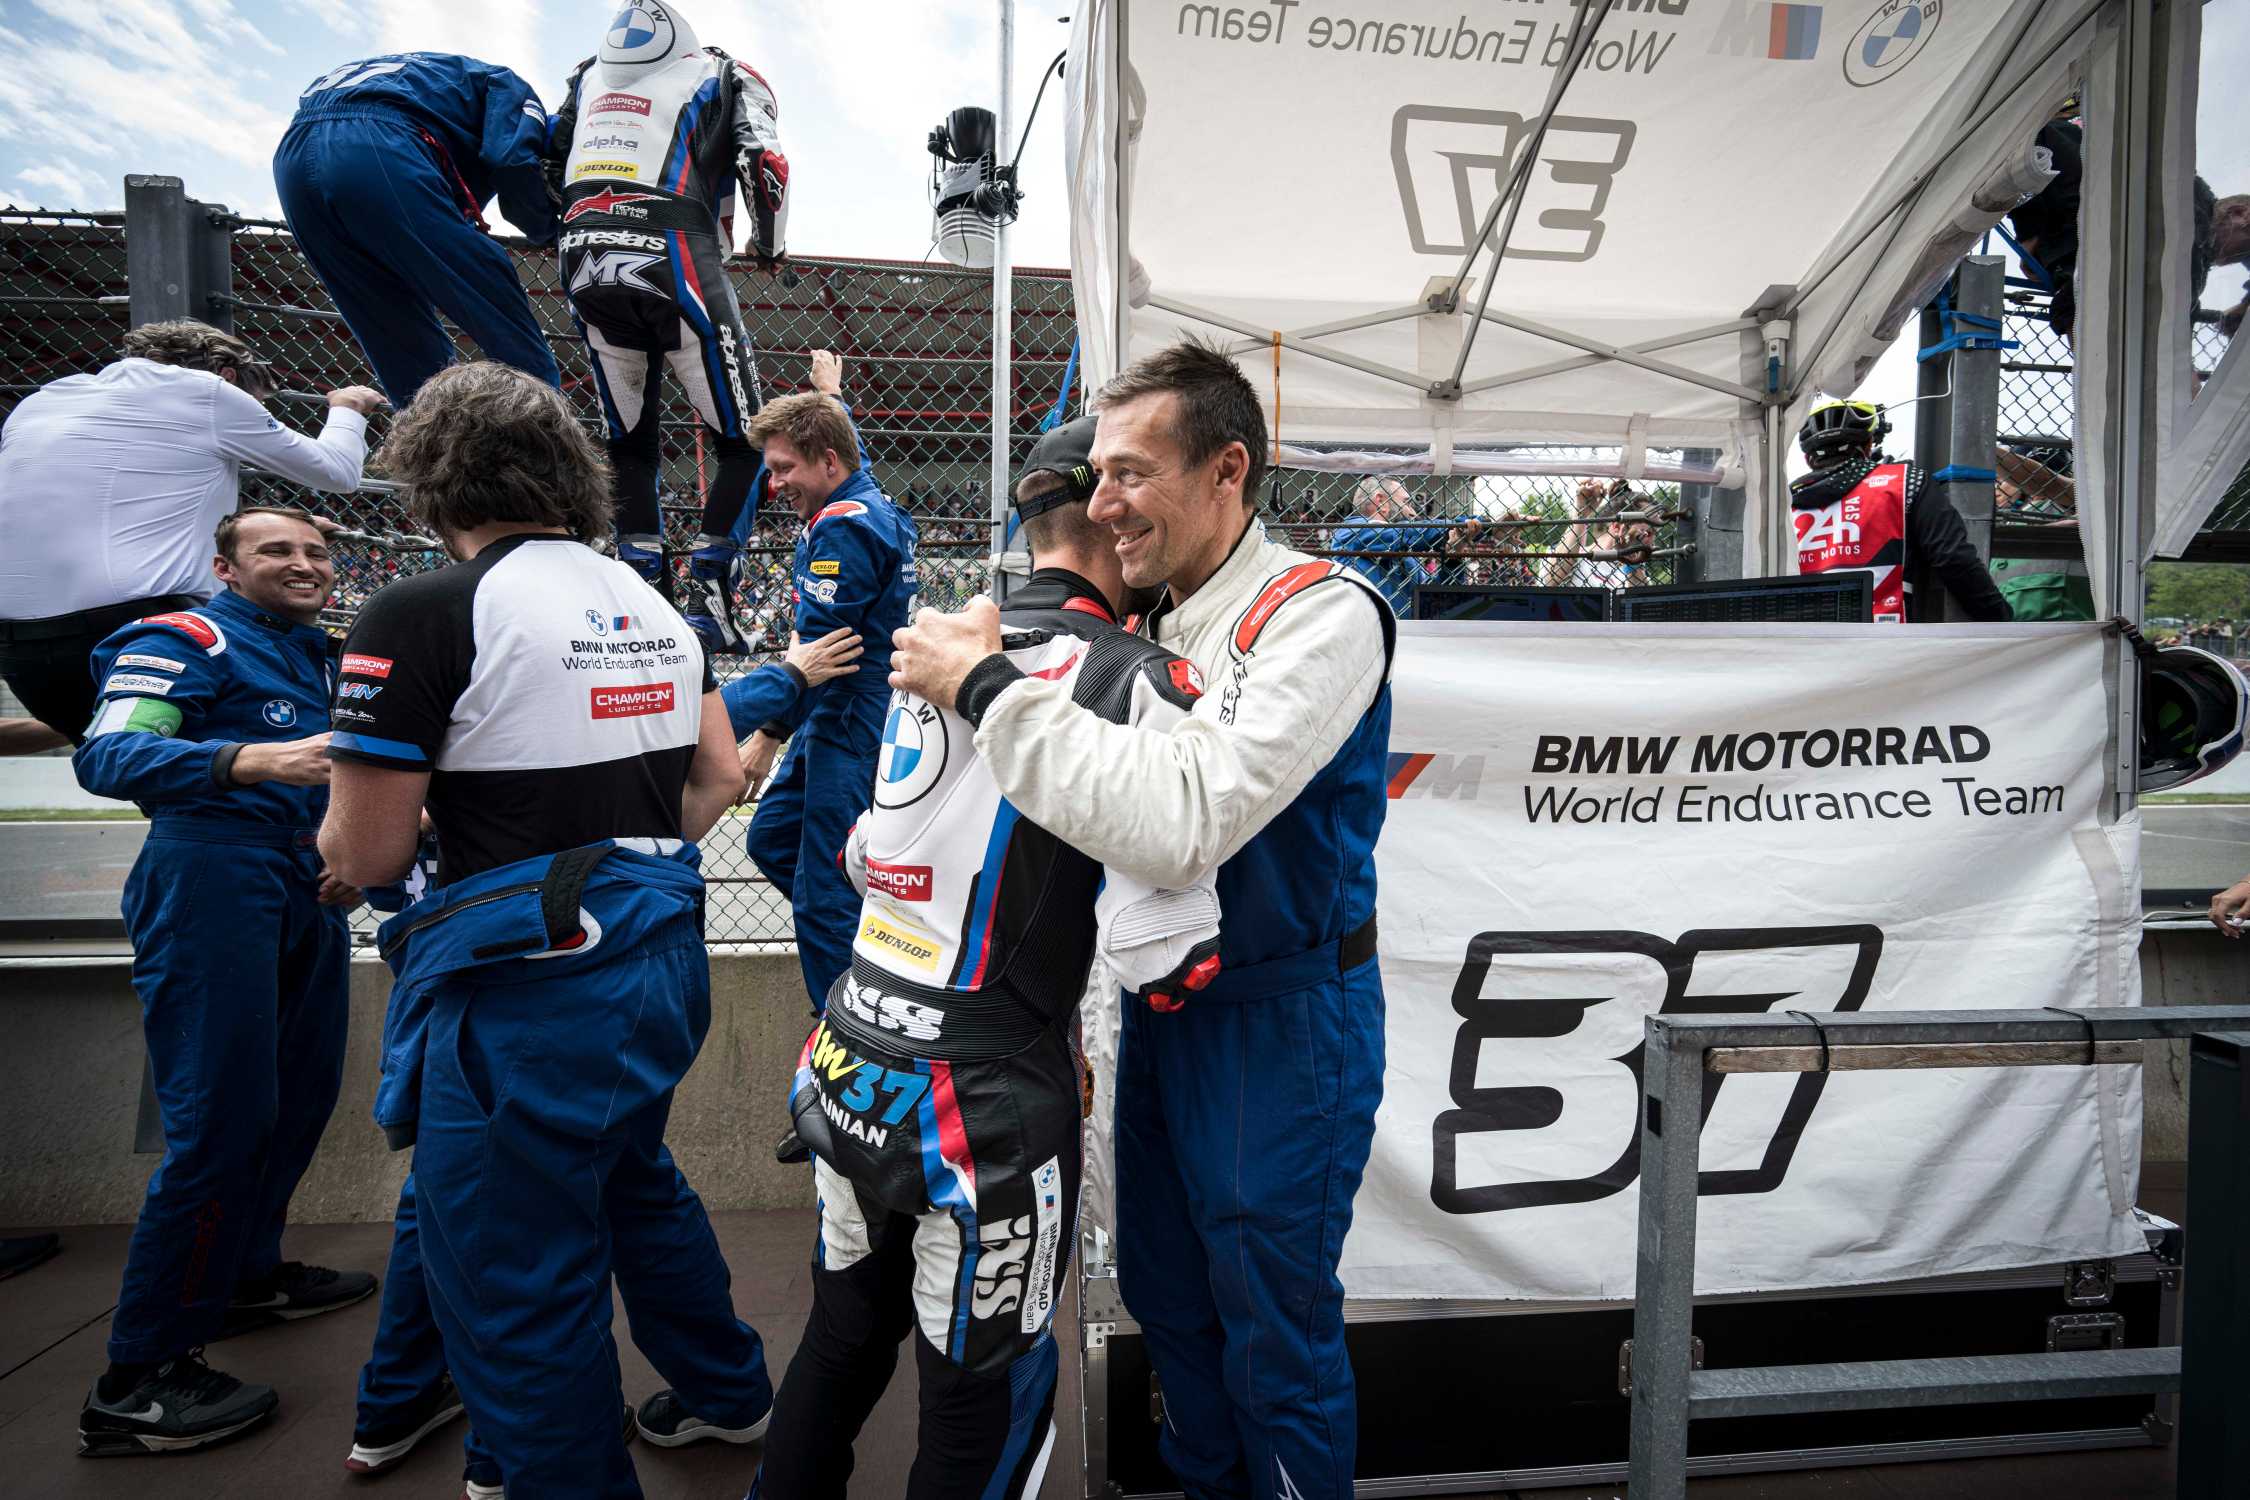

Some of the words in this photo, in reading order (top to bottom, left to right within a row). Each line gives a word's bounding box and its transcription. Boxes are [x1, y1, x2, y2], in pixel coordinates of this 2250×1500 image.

[584, 164, 634, 173] DUNLOP
[560, 230, 667, 253] alpinestars
[1845, 496, 1860, 521] SPA
[1798, 554, 1815, 564] WC
[1821, 545, 1861, 560] MOTOS
[571, 640, 603, 654] BMW
[562, 656, 602, 670] World
[657, 653, 688, 666] Team
[595, 690, 670, 706] CHAMPION
[1531, 735, 1681, 774] BMW
[1690, 725, 1991, 773] MOTORRAD
[1524, 785, 1664, 823] World
[1676, 784, 1932, 823] Endurance
[1941, 777, 2065, 816] Team
[874, 930, 933, 960] DUNLOP
[1431, 924, 1884, 1214] 37
[840, 1056, 932, 1125] 37
